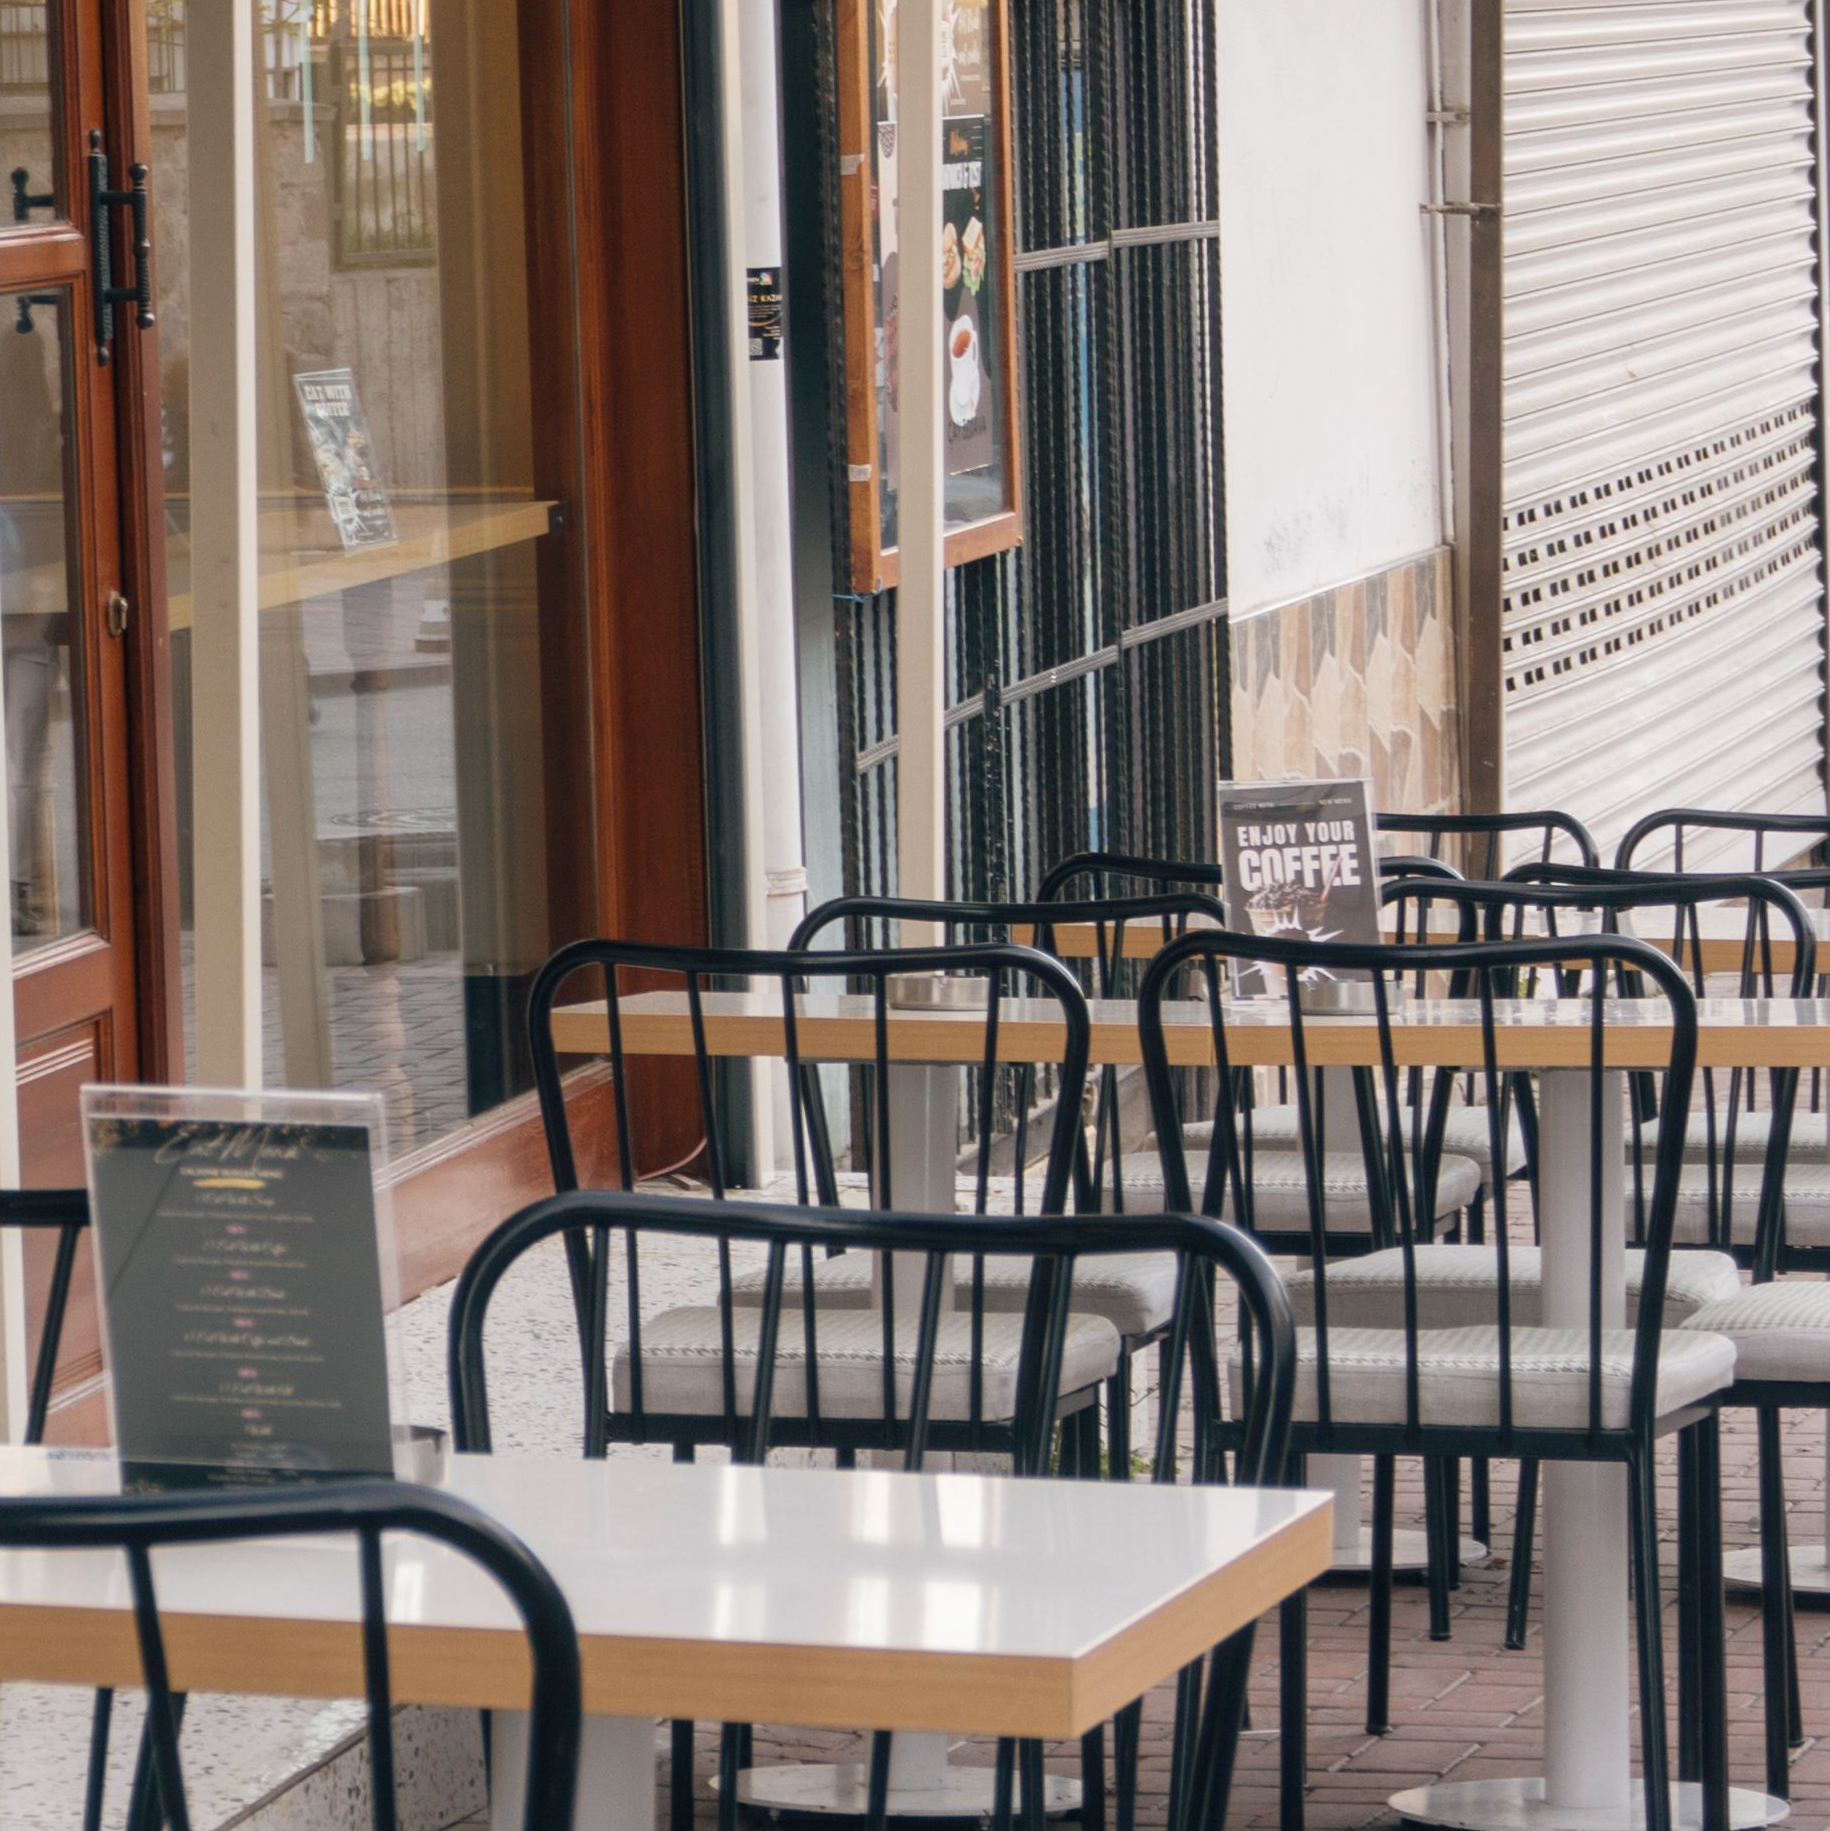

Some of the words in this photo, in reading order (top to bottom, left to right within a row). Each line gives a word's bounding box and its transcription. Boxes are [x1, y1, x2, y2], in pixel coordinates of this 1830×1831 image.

[1236, 823, 1297, 847] ENJOY
[1304, 820, 1355, 843] YOUR
[1237, 843, 1362, 892] COFFEE
